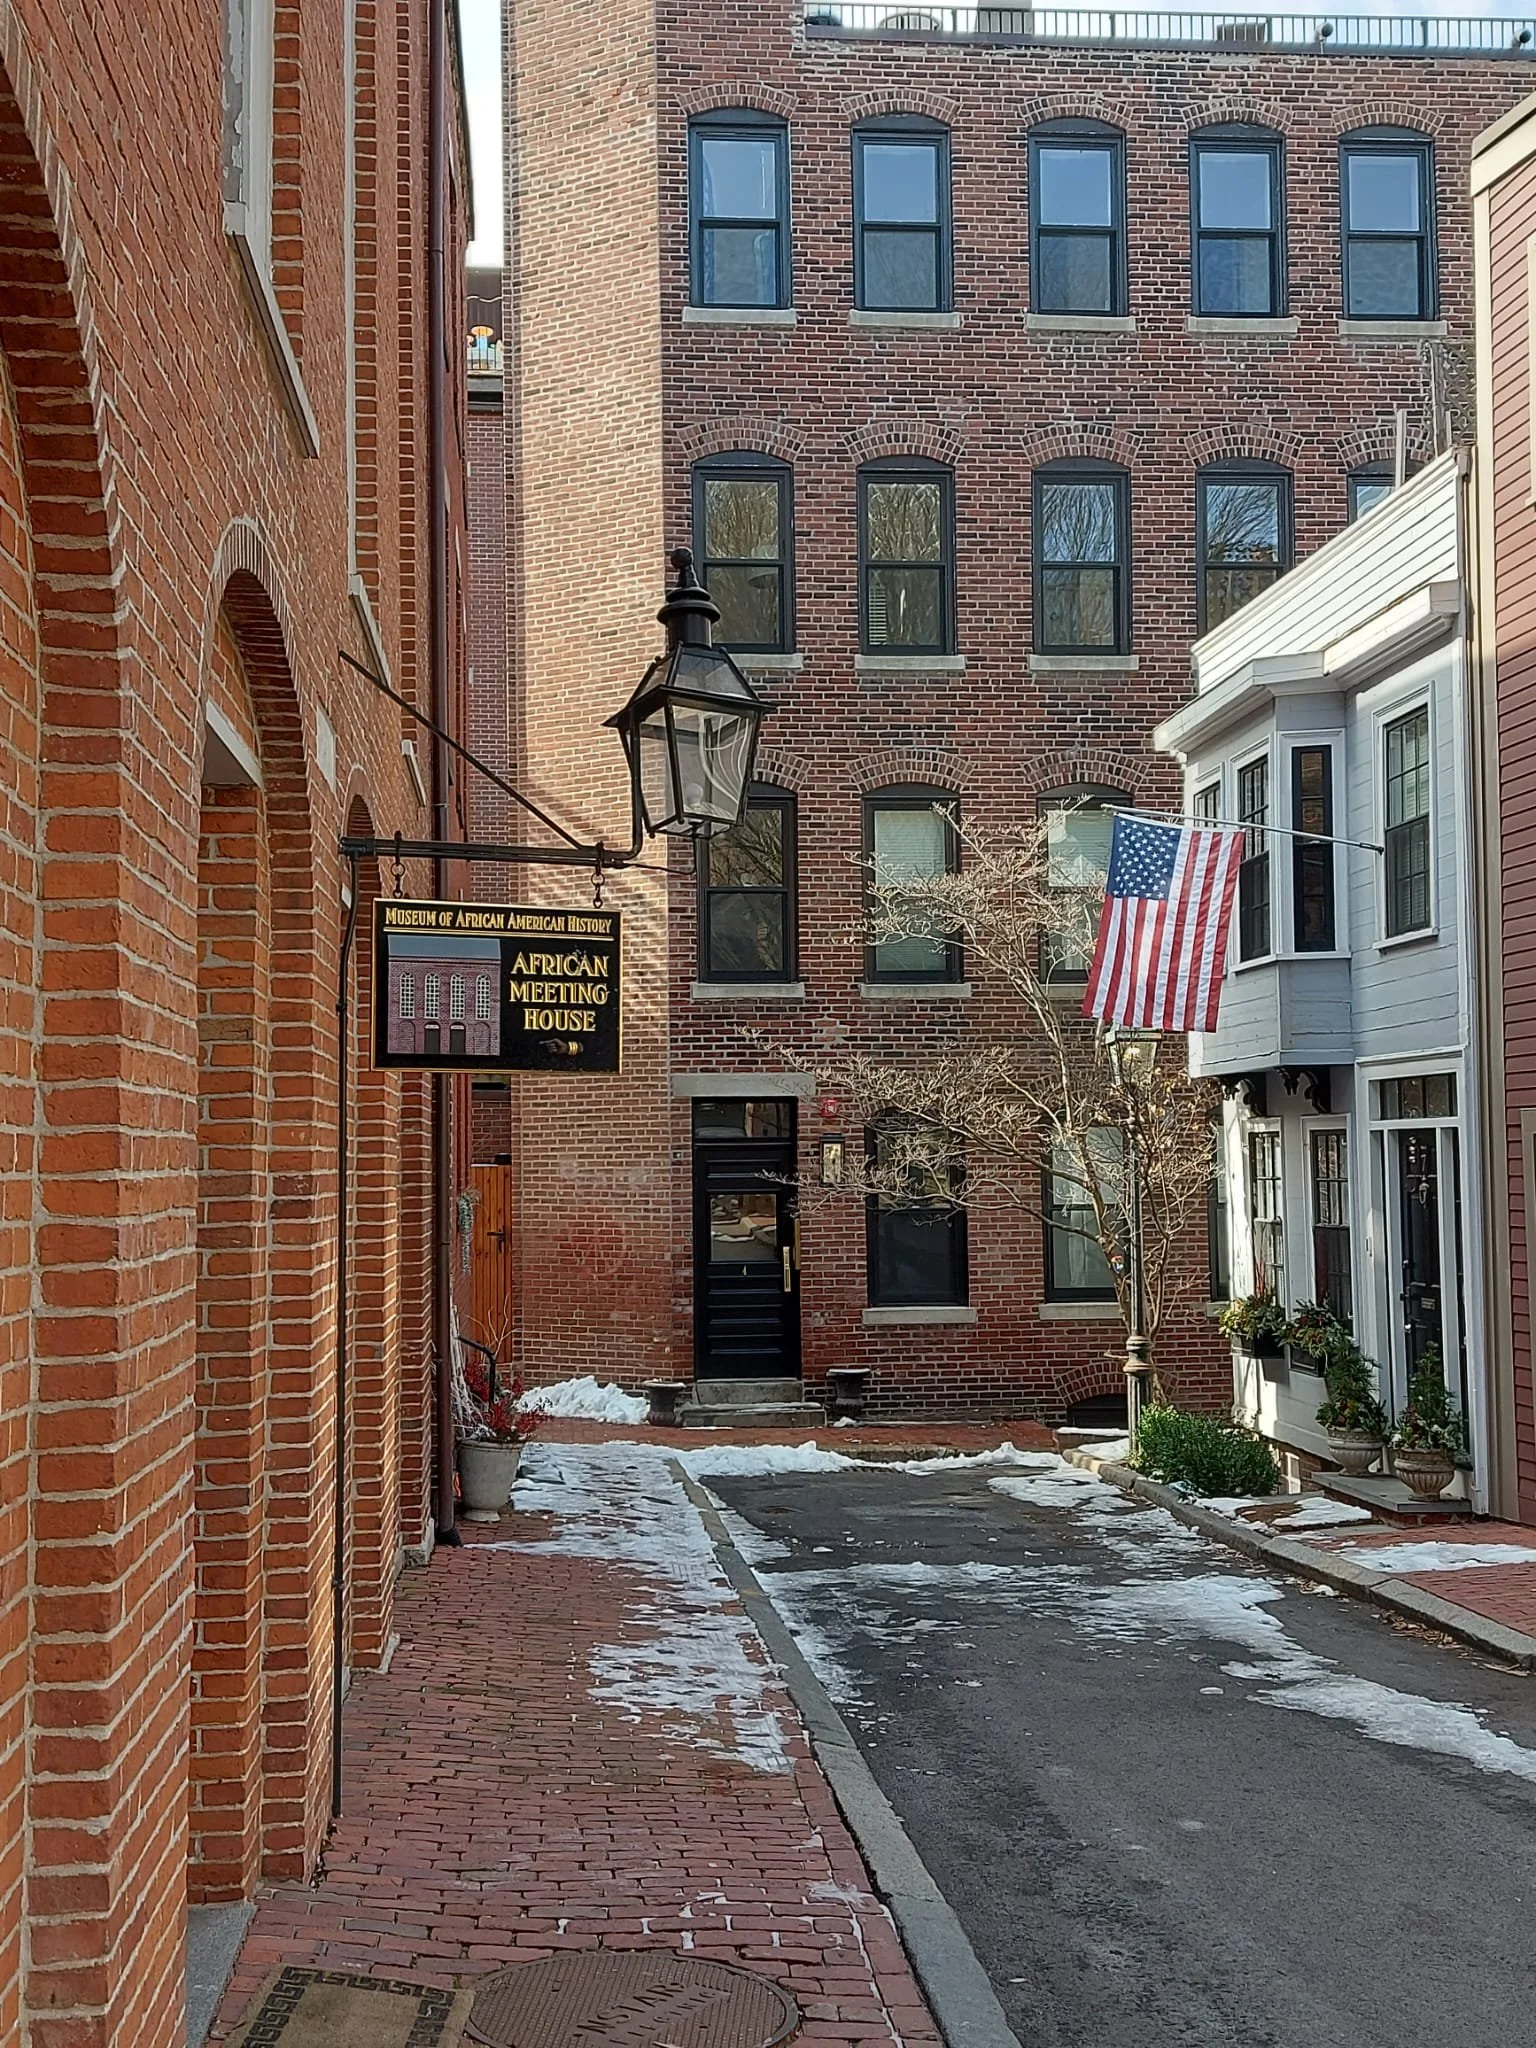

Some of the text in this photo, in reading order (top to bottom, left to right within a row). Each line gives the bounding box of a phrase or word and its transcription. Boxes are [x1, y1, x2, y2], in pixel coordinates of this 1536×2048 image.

[384, 907, 612, 934] MUSEUM OF AFRICAN AMERICAN HISTORY
[510, 951, 609, 977] AFRICAN
[509, 980, 610, 1005] MEETING
[523, 1008, 596, 1032] HOUSE
[577, 1984, 684, 2035] NSTAR
